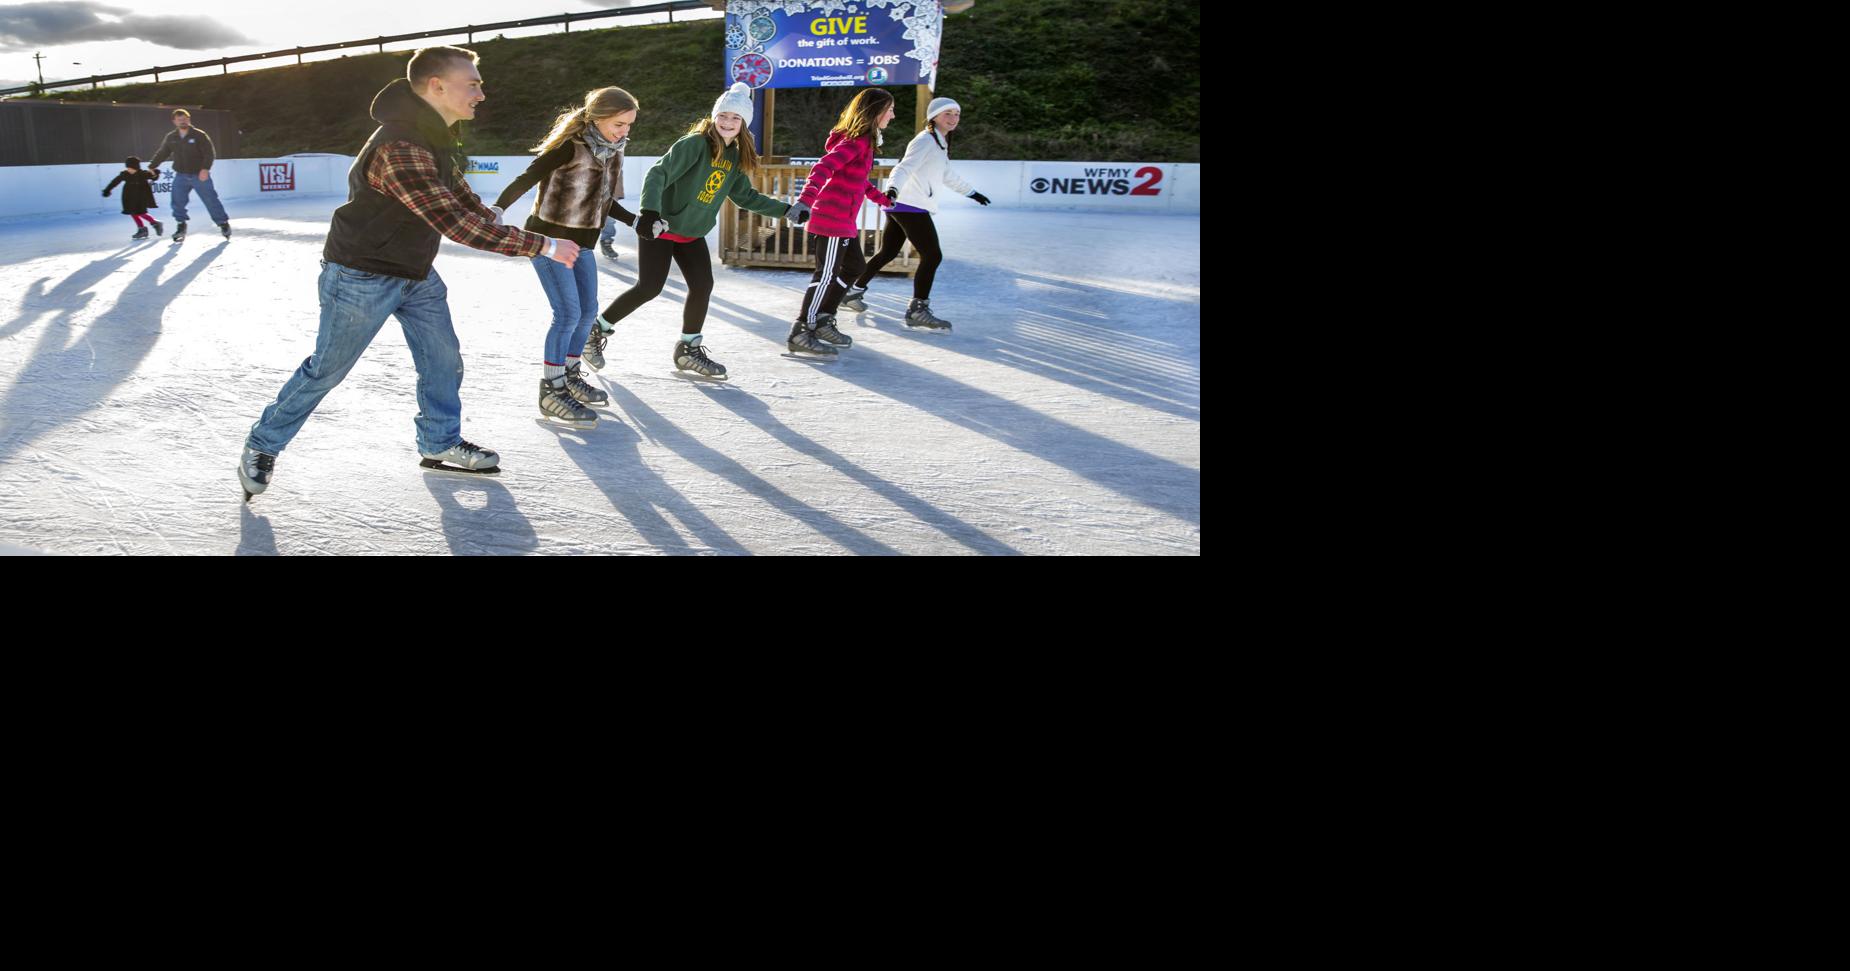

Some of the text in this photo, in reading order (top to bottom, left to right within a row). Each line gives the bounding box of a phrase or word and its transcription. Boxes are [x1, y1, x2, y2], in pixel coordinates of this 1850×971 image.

[810, 16, 867, 35] GIVE
[797, 36, 880, 49] the gift of work.
[778, 57, 853, 68] DONATIONS
[867, 55, 900, 65] JOBS
[261, 162, 291, 183] YES!
[1084, 168, 1131, 178] WFMY
[1051, 166, 1163, 196] NEWS 2
